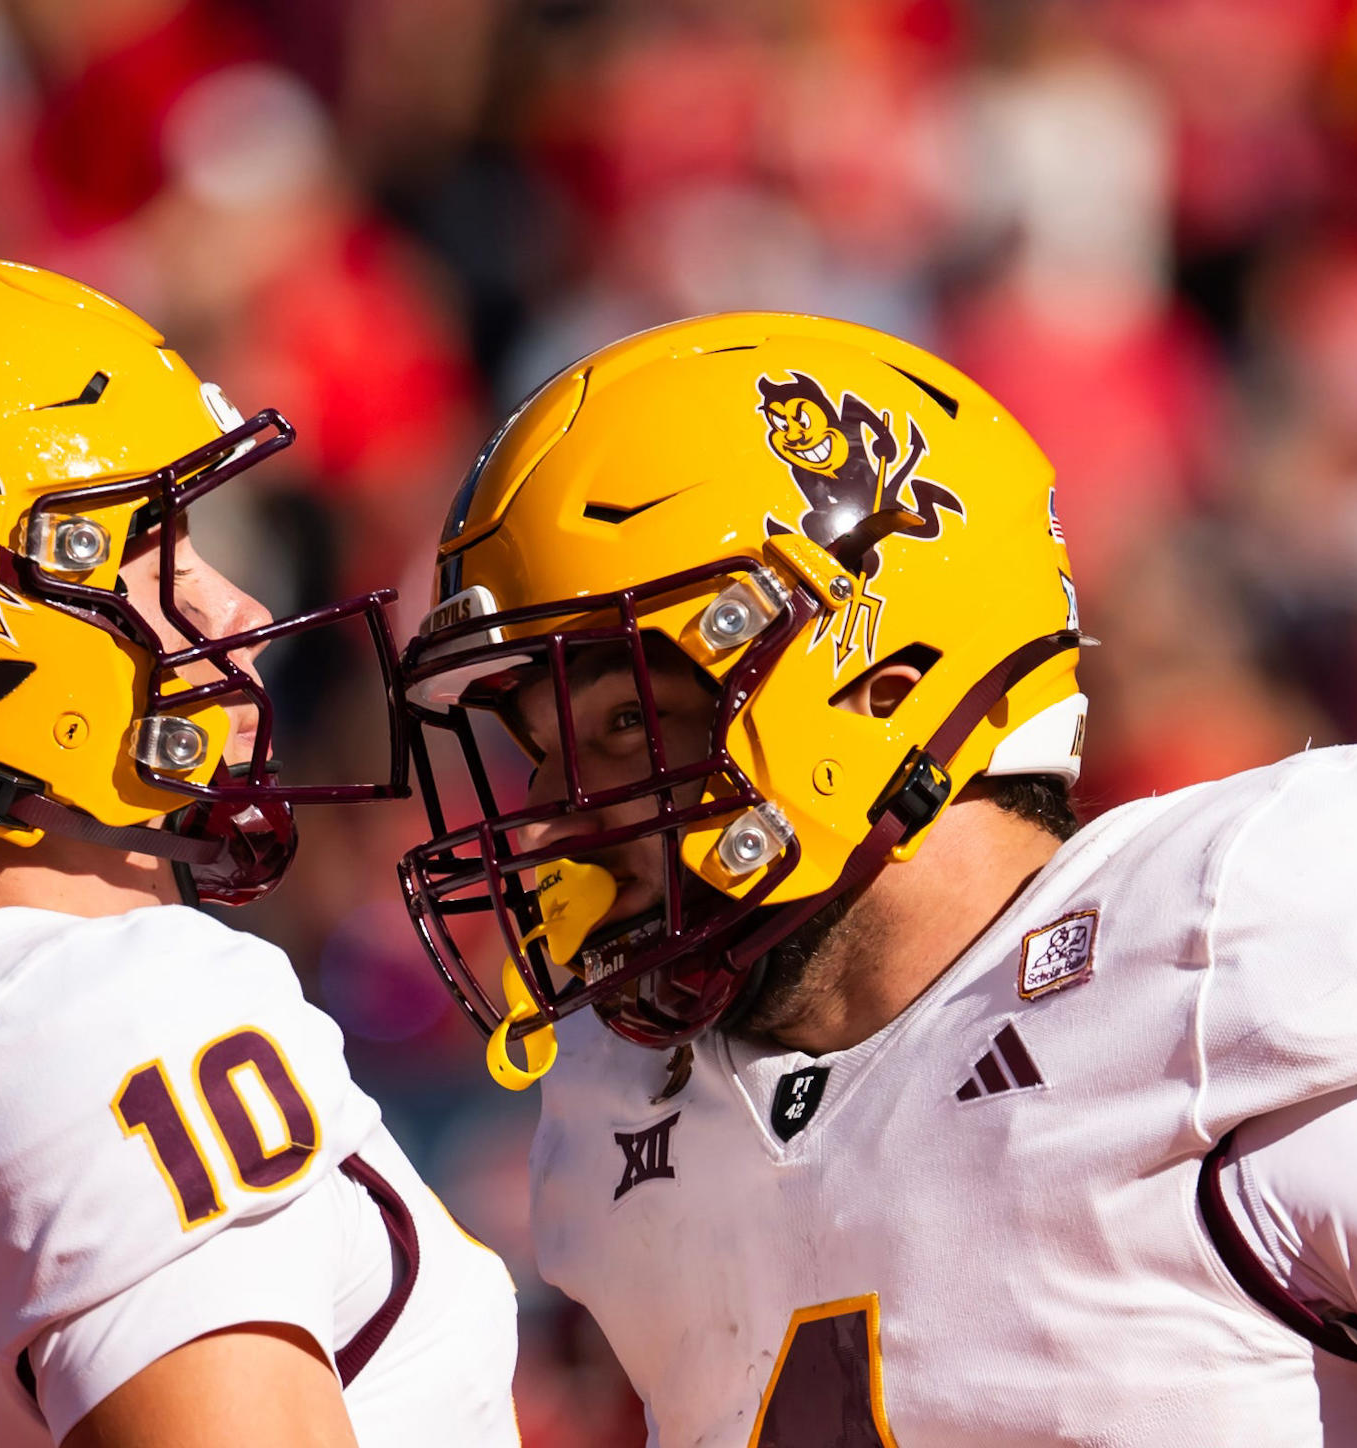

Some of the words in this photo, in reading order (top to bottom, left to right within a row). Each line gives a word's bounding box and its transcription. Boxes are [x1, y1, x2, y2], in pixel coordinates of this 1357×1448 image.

[784, 1102, 806, 1120] 42
[792, 1075, 814, 1095] PT
[109, 1025, 322, 1231] 10
[613, 1110, 682, 1201] XII
